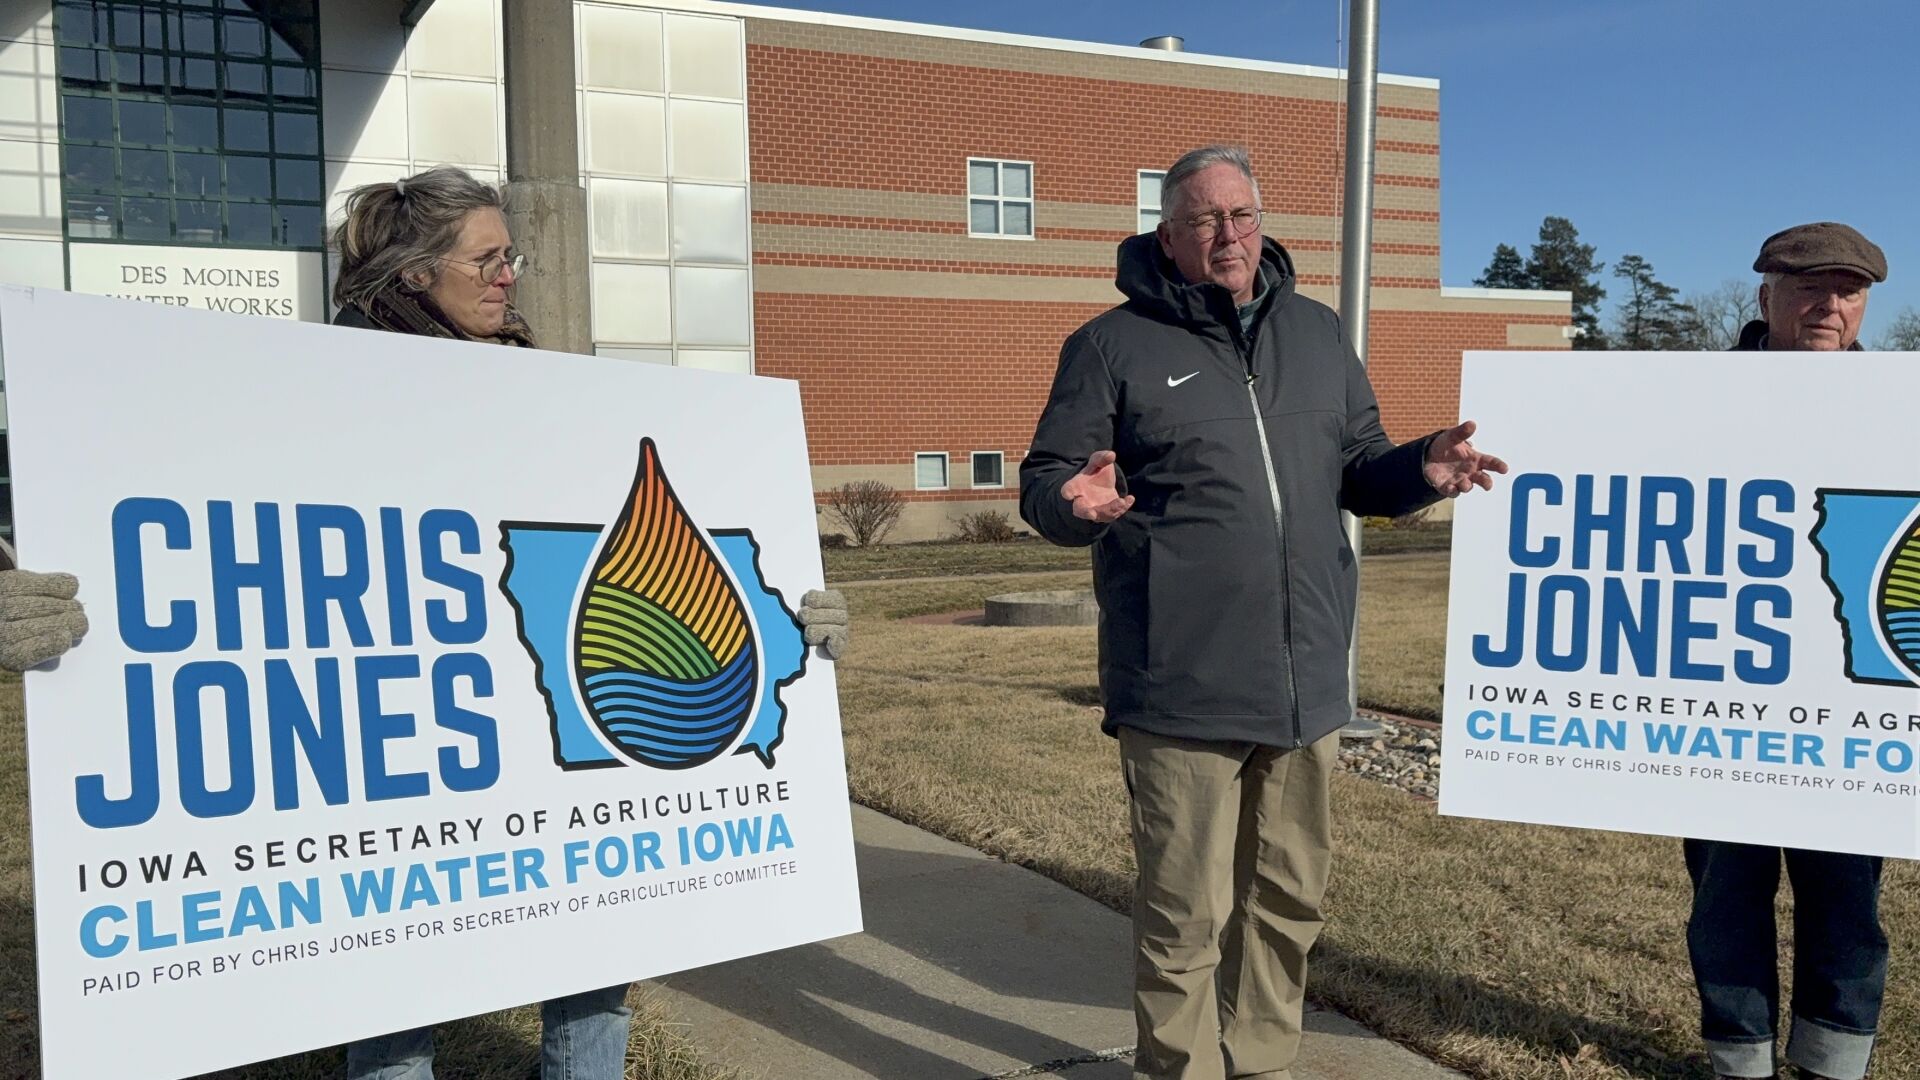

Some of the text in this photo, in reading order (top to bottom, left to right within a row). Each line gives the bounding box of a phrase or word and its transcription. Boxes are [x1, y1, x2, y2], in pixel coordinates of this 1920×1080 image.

[121, 266, 279, 288] DES MOINES
[205, 297, 293, 316] WORKS
[112, 497, 487, 653] CHRIS
[1509, 473, 1795, 578] CHRIS
[1472, 573, 1792, 685] JONES
[75, 652, 500, 829] JONES
[1467, 710, 1920, 775] CLEAN WATER FO
[1469, 685, 1548, 705] IOWA
[1568, 692, 1768, 720] SECRETARY
[1790, 707, 1830, 725] OF
[1466, 749, 1920, 797] PAID FOR BY CHRIS JONES FOR SECRETARY OF AGRI
[79, 781, 789, 892] IOWA SECRETARY OF AGRICULTURE
[80, 814, 794, 958] CLEAN WATER FOR IOWA
[84, 861, 797, 996] PAID FOR BY CHRIS JONES FOR SECRETARY OF AGRICULTURE COMMITTEE
